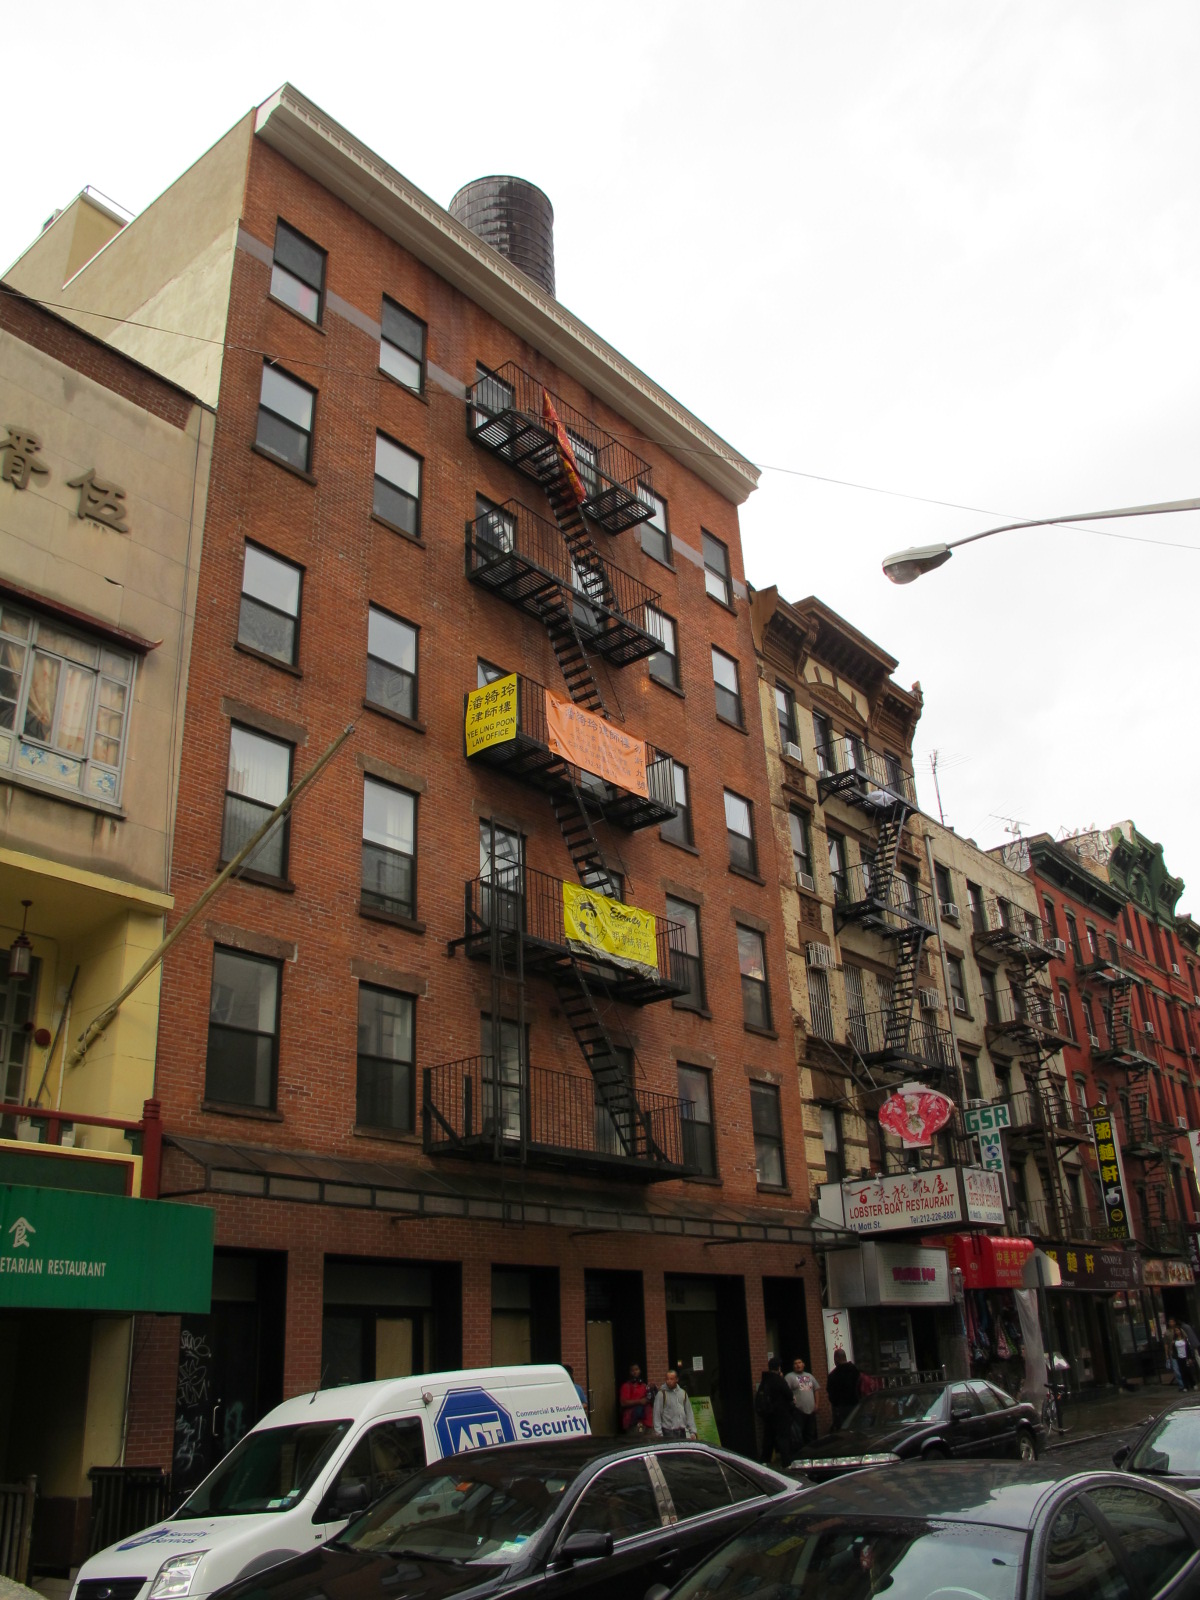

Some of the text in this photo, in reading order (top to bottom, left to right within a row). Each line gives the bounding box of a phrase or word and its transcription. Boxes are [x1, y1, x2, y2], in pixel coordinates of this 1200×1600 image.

[470, 701, 512, 725] 律師樓
[467, 717, 515, 740] YEE LING POON
[472, 728, 509, 748] LAW OFFICE
[964, 1105, 1009, 1133] GSR
[849, 1204, 883, 1220] LOBSTER
[884, 1200, 904, 1215] BOAT
[905, 1194, 955, 1212] RESTAURANT
[8, 1216, 36, 1248] 食
[858, 1221, 872, 1231] Mott
[48, 1259, 107, 1277] RESTAURANT
[515, 1407, 549, 1418] Commercial
[458, 1421, 501, 1452] ADT
[519, 1415, 588, 1439] Security
